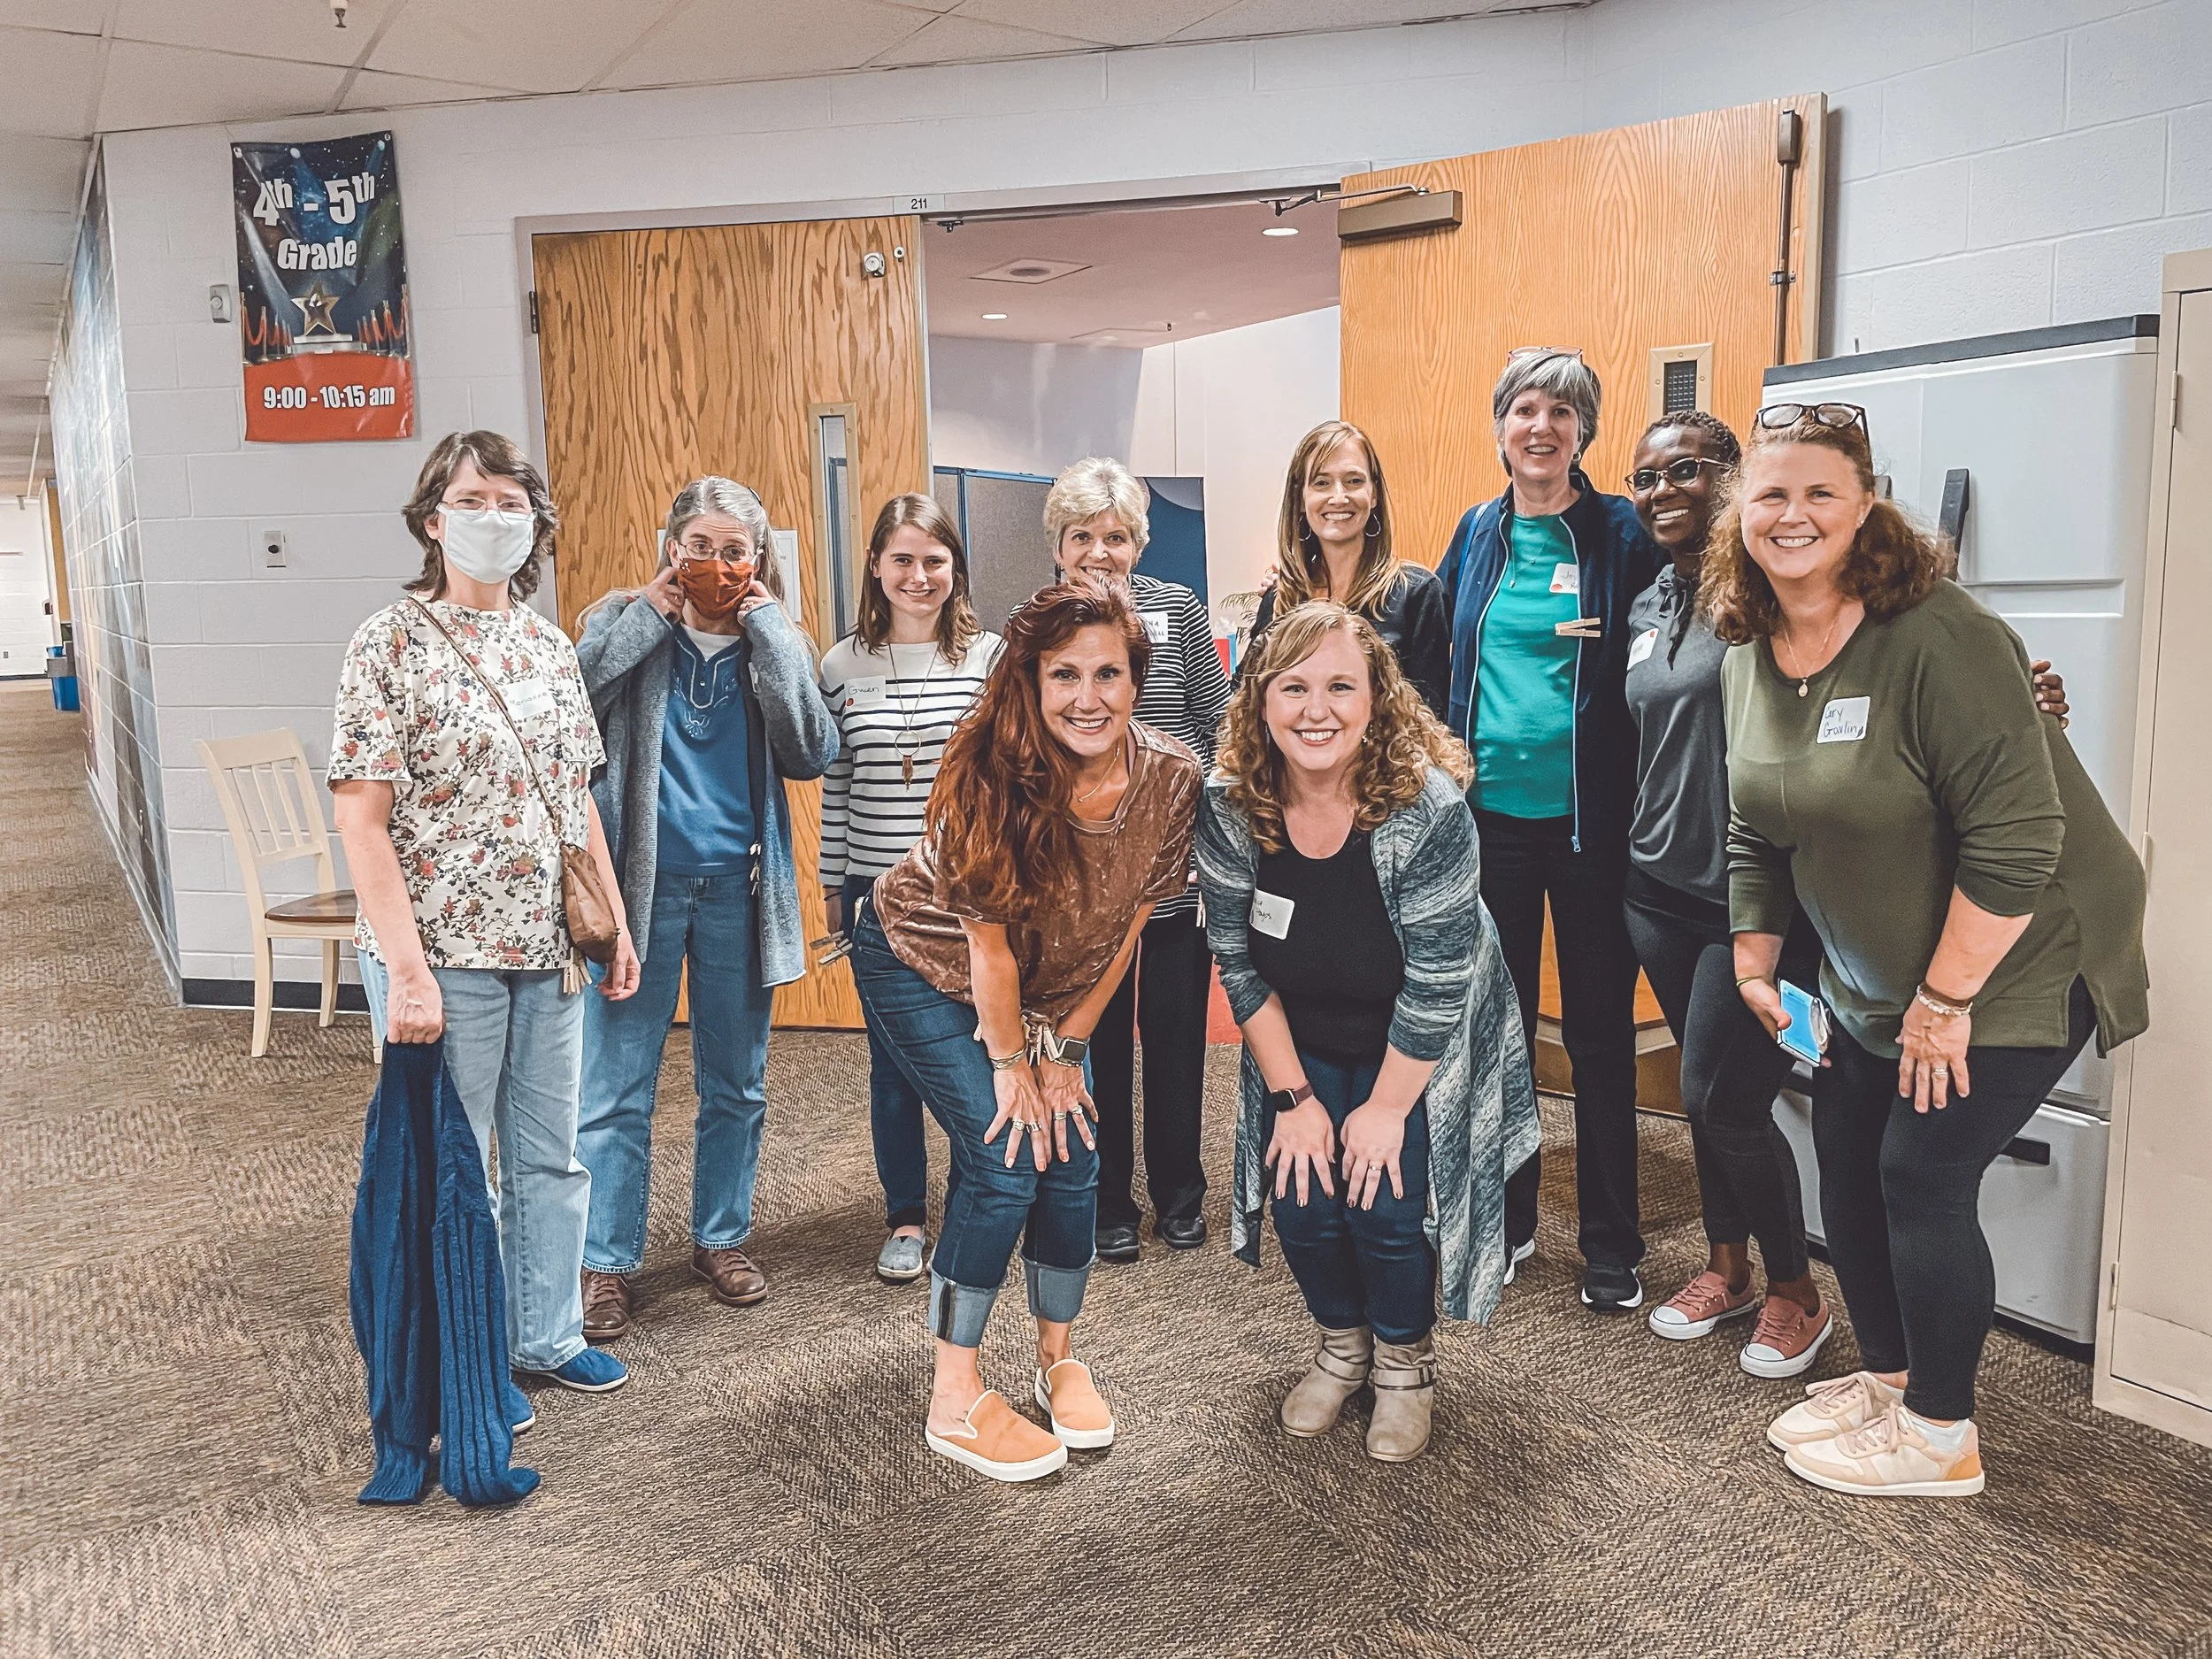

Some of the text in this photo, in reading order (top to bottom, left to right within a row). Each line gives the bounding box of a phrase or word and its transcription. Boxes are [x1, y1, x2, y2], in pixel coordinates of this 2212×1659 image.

[253, 179, 293, 227] 4th
[325, 172, 376, 225] 5th
[910, 198, 927, 210] 211
[277, 236, 357, 271] Grade
[264, 387, 308, 409] 9:00
[319, 385, 365, 409] 10:15
[369, 386, 396, 405] am
